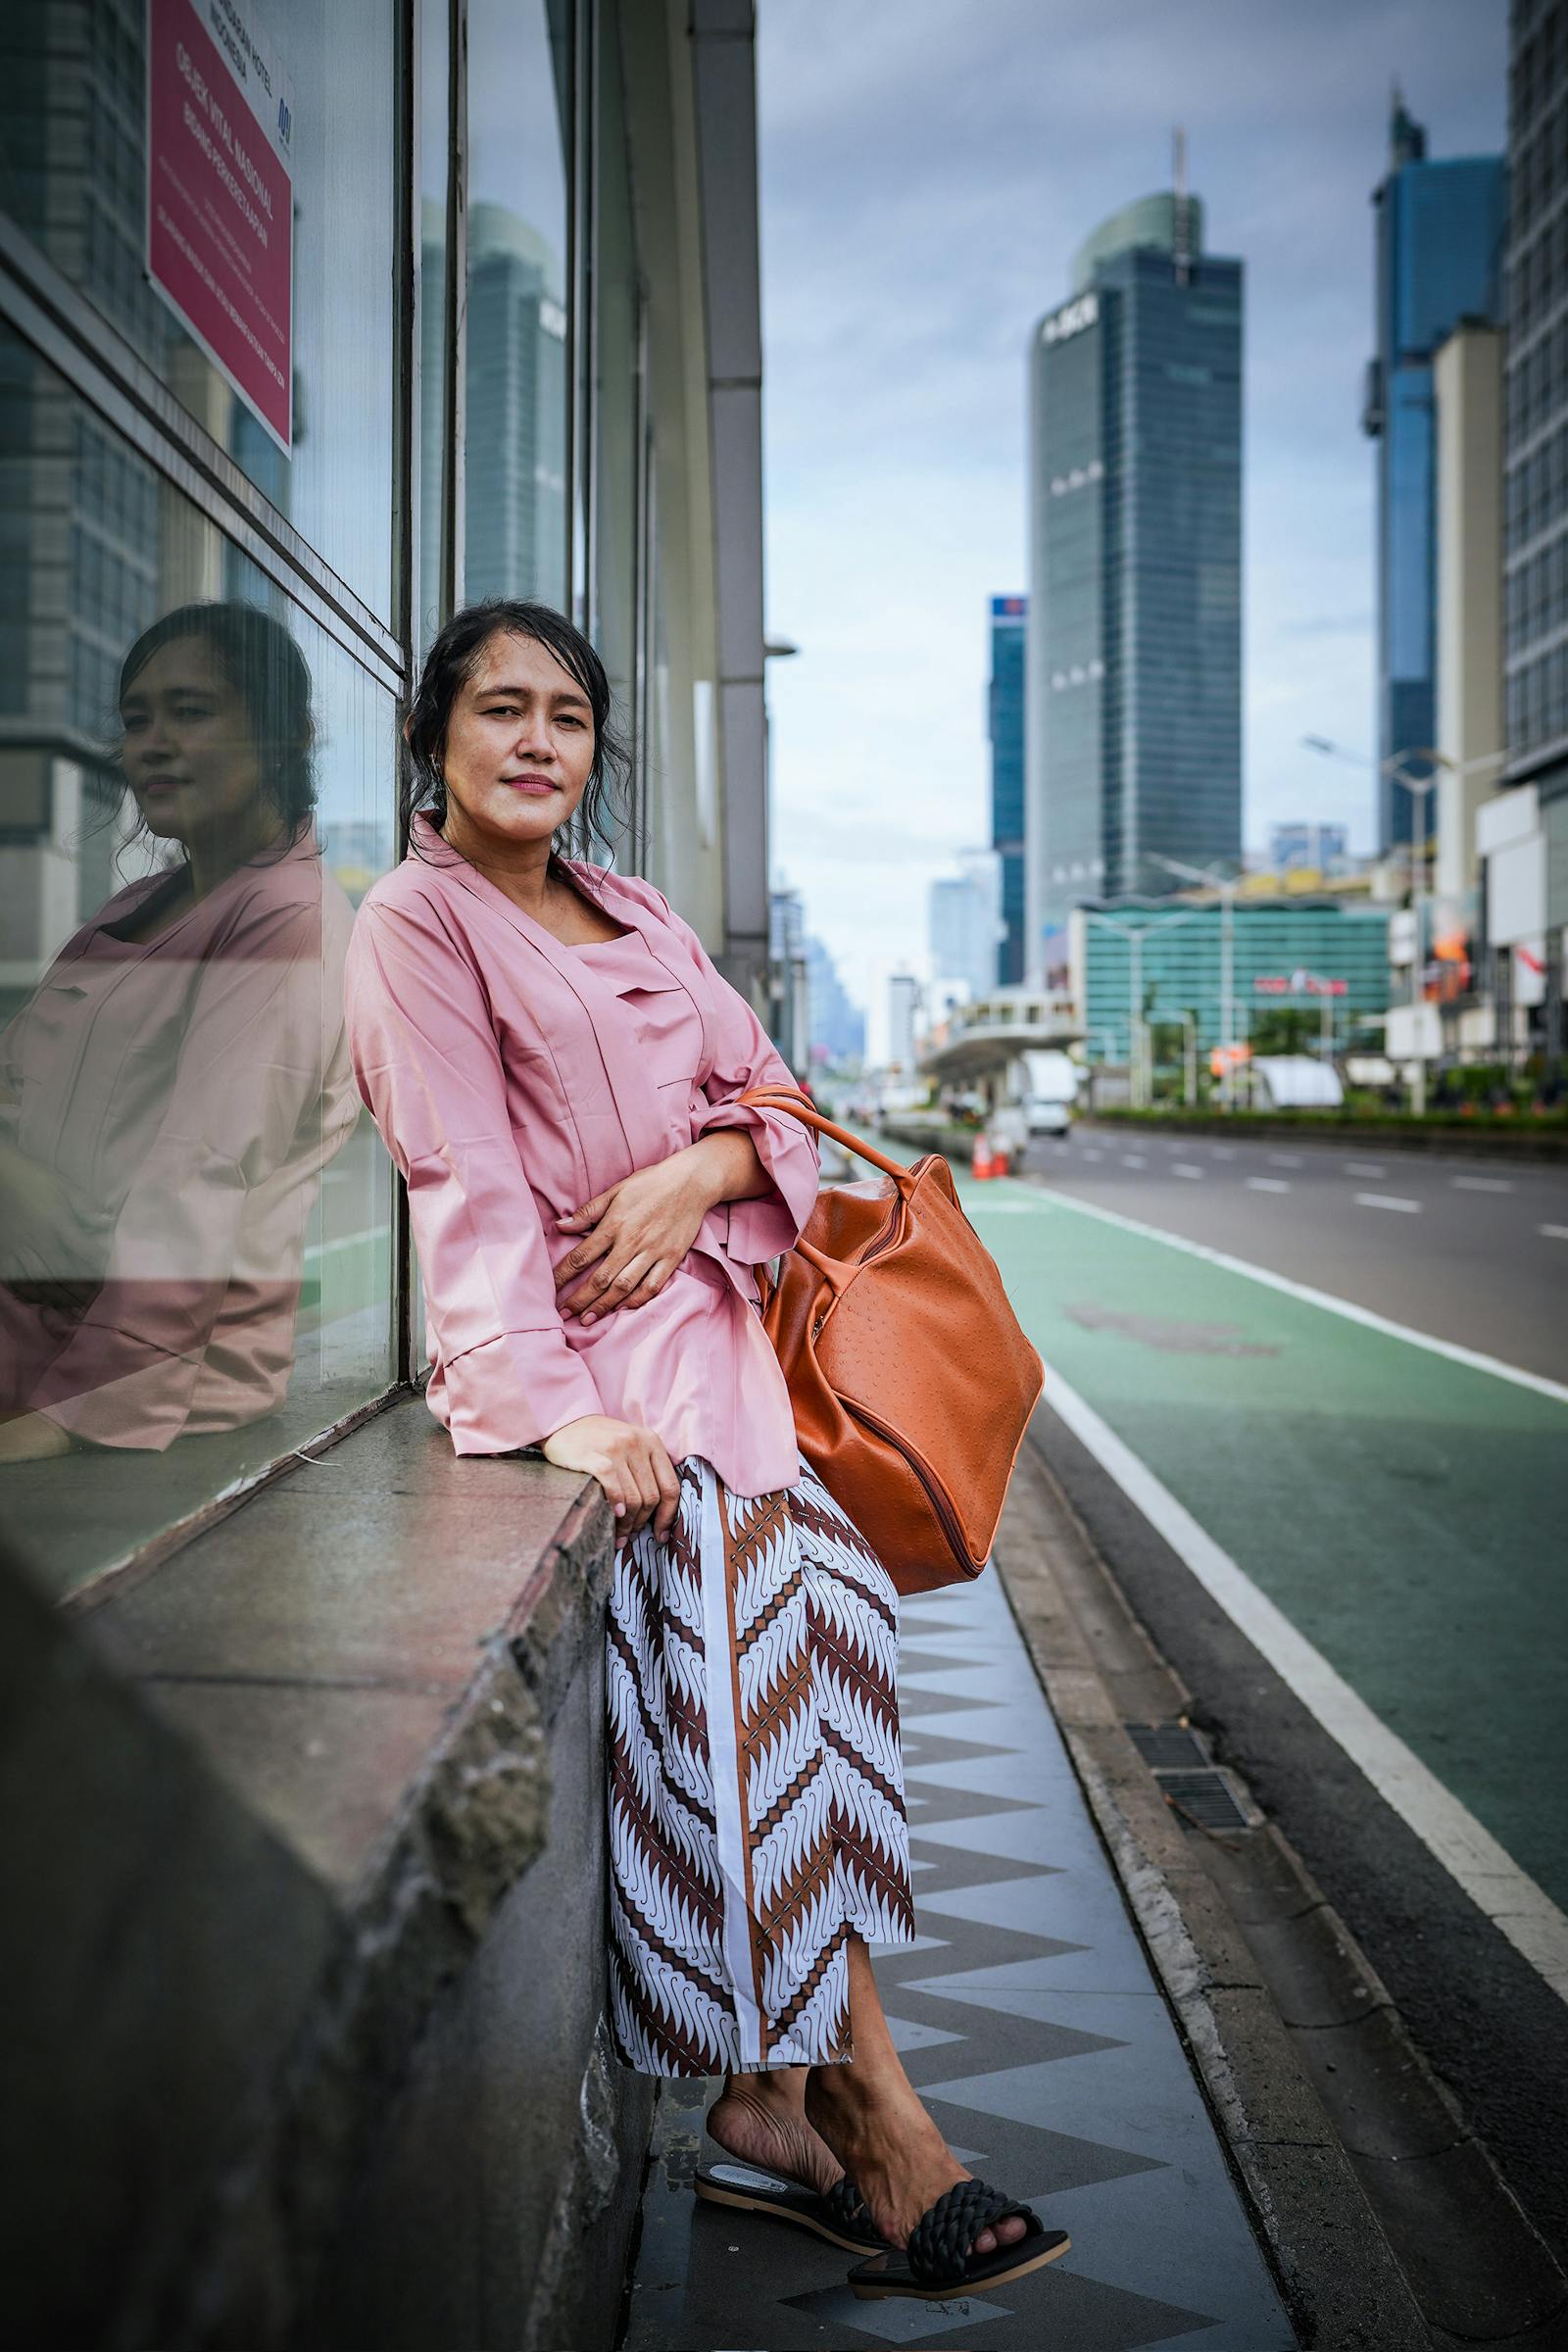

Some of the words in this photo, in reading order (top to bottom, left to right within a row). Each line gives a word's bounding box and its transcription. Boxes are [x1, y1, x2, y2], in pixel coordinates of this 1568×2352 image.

[210, 1, 248, 84] INDONESIA
[252, 45, 272, 98] HOTEL
[175, 41, 209, 113] OBJEK
[209, 95, 234, 154] VITAL
[234, 138, 273, 220] NASIONAL
